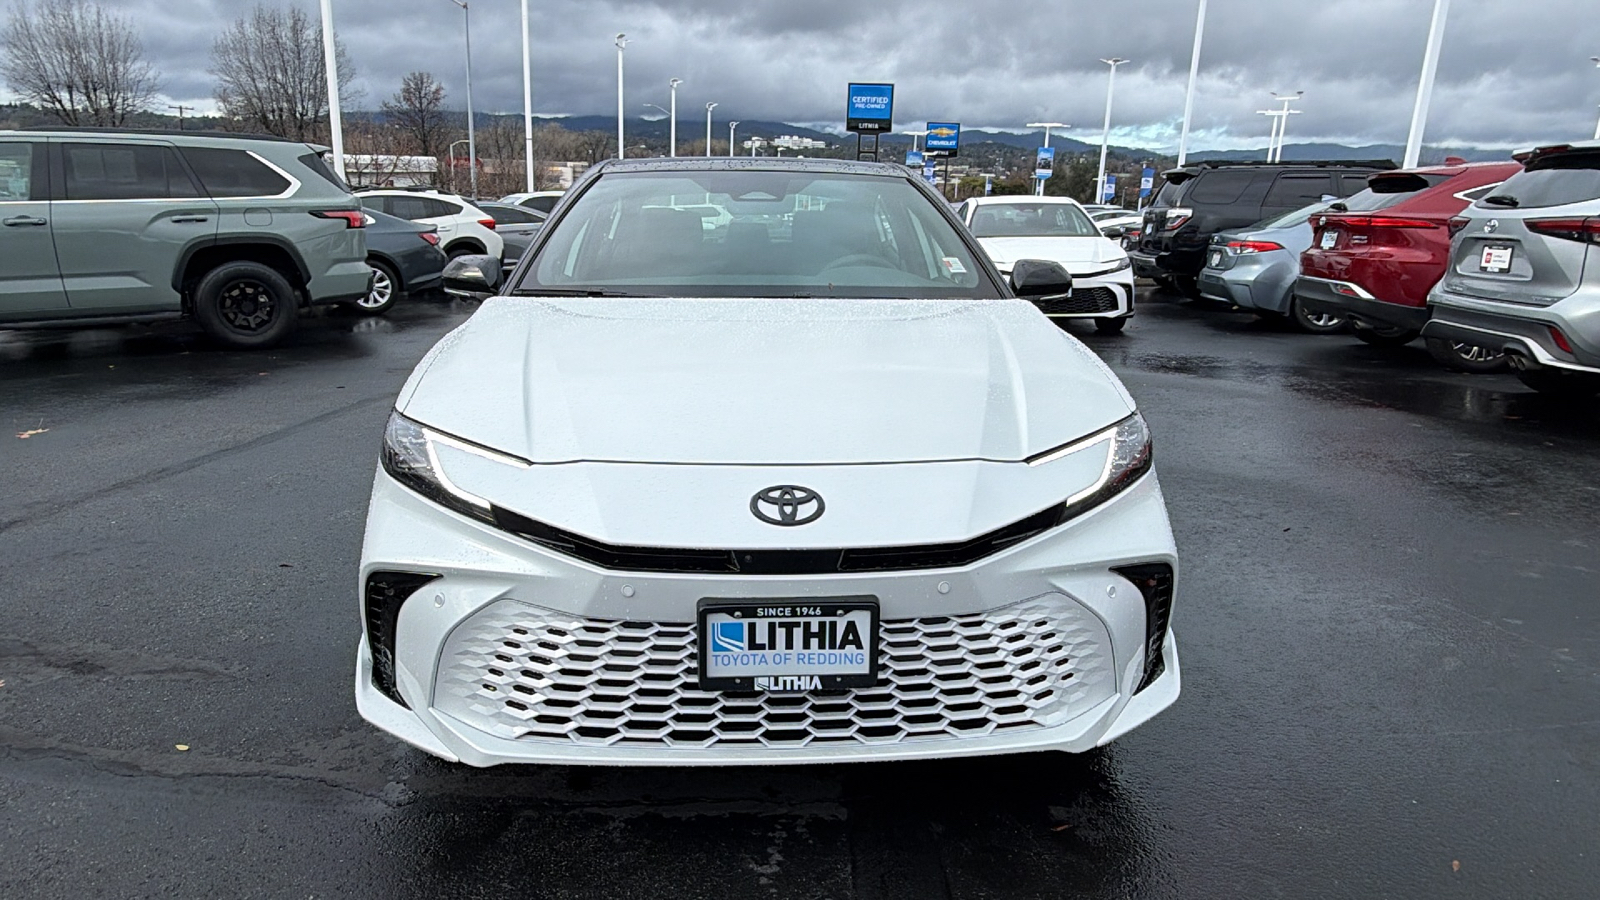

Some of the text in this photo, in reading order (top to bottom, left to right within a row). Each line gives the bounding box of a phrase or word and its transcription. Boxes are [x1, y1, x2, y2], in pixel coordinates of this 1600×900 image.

[852, 96, 889, 104] CERTIFIED
[756, 607, 822, 617] SINCE 1946
[747, 620, 864, 651] LITHIA
[712, 652, 865, 667] TOYOTA OF REDDING
[769, 675, 823, 691] LITHIA
